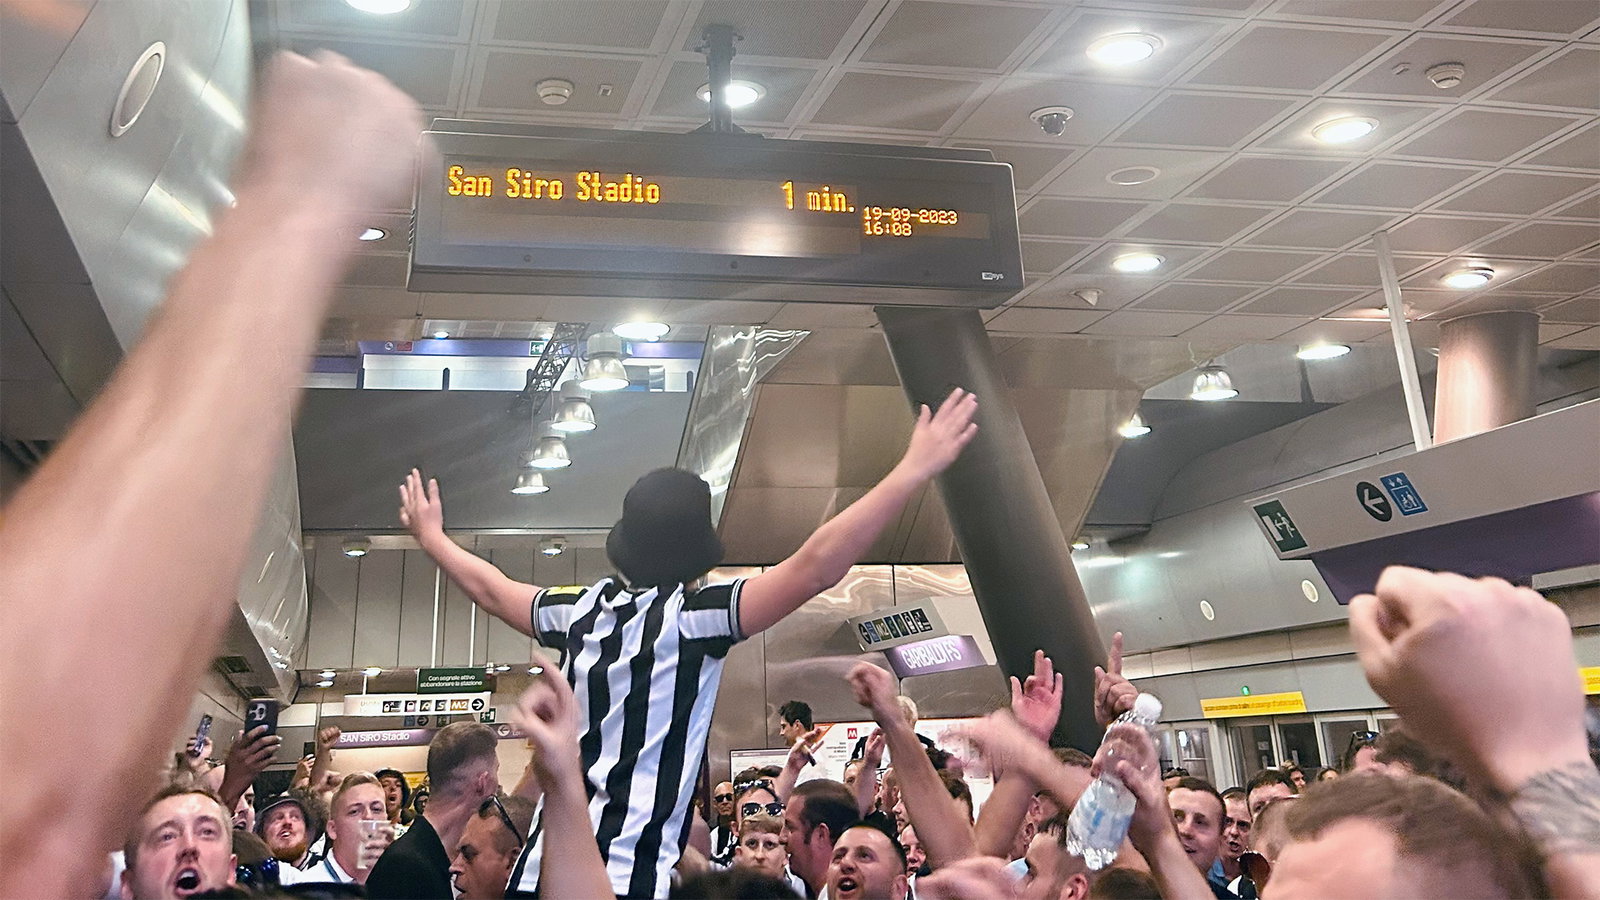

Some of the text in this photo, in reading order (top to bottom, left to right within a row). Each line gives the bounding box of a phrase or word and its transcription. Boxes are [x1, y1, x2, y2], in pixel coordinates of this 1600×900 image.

[448, 165, 856, 213] San Siro Stadio 1 min.
[863, 206, 958, 225] 19-09-2023
[864, 221, 912, 236] 16:08
[451, 700, 468, 709] M2
[340, 731, 410, 743] SAN SIRO Stadio
